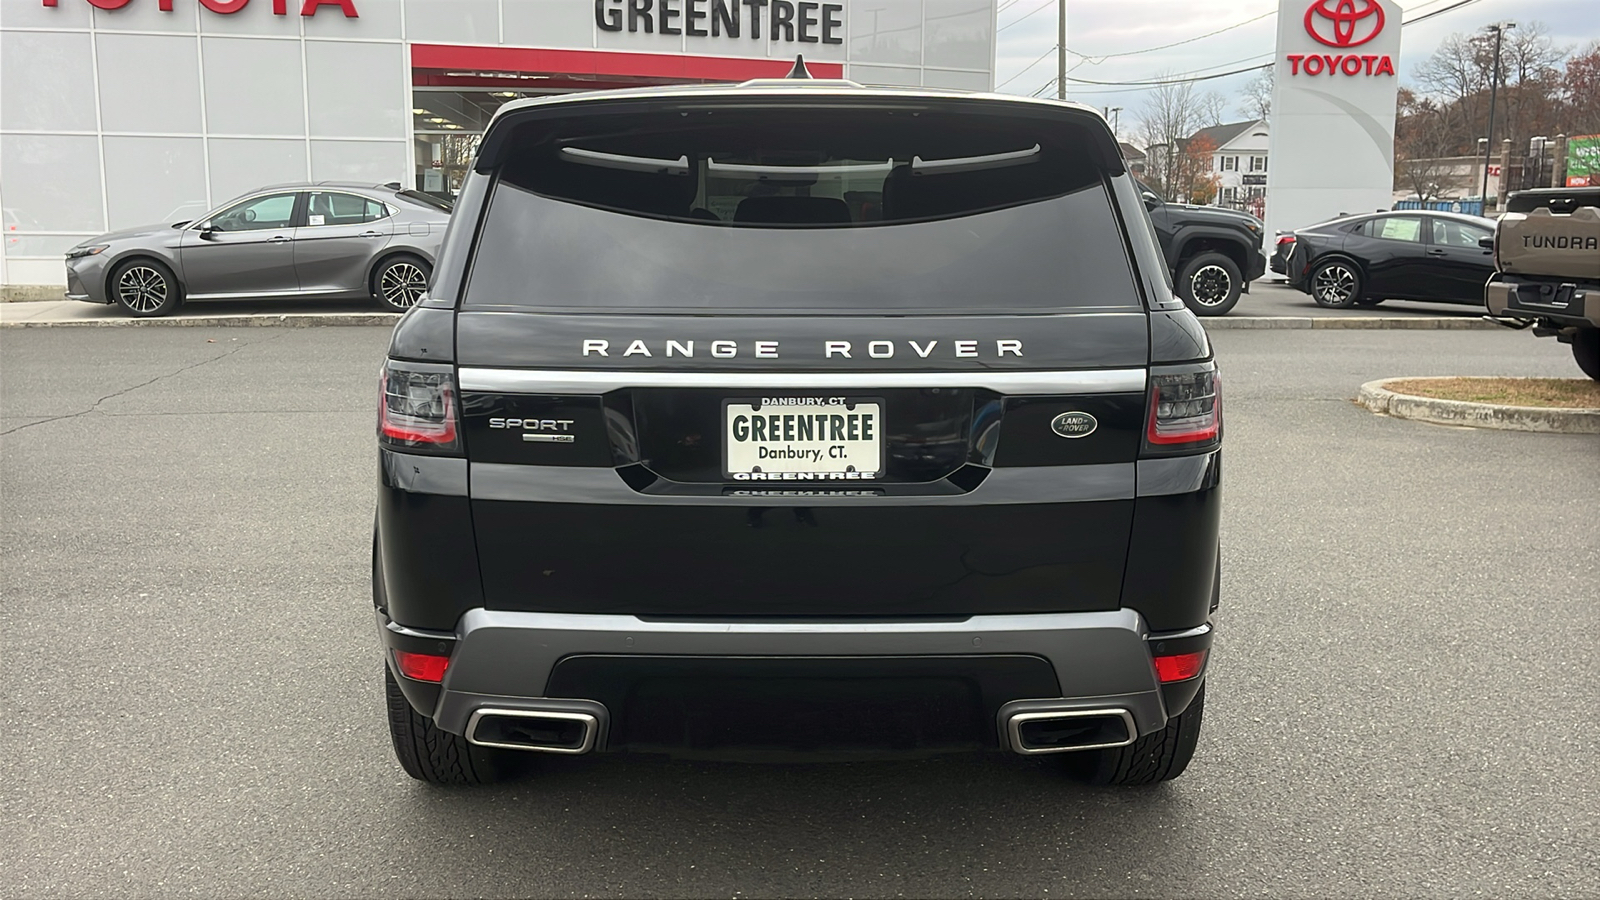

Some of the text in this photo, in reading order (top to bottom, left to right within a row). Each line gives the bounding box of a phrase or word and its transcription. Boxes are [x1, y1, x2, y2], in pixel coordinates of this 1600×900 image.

[595, 0, 843, 44] GREENTREE
[1286, 54, 1395, 76] TOYOTA
[1522, 235, 1598, 250] TUNDRA
[582, 339, 1025, 359] RANGE ROVER
[761, 397, 846, 407] DANBURY, CT
[489, 418, 574, 431] SPORT
[732, 413, 874, 442] GREENTREE
[1061, 417, 1084, 425] LAND
[1062, 424, 1090, 432] ROVER
[758, 445, 848, 463] Danbury, CT.
[732, 471, 875, 481] GREENTREE
